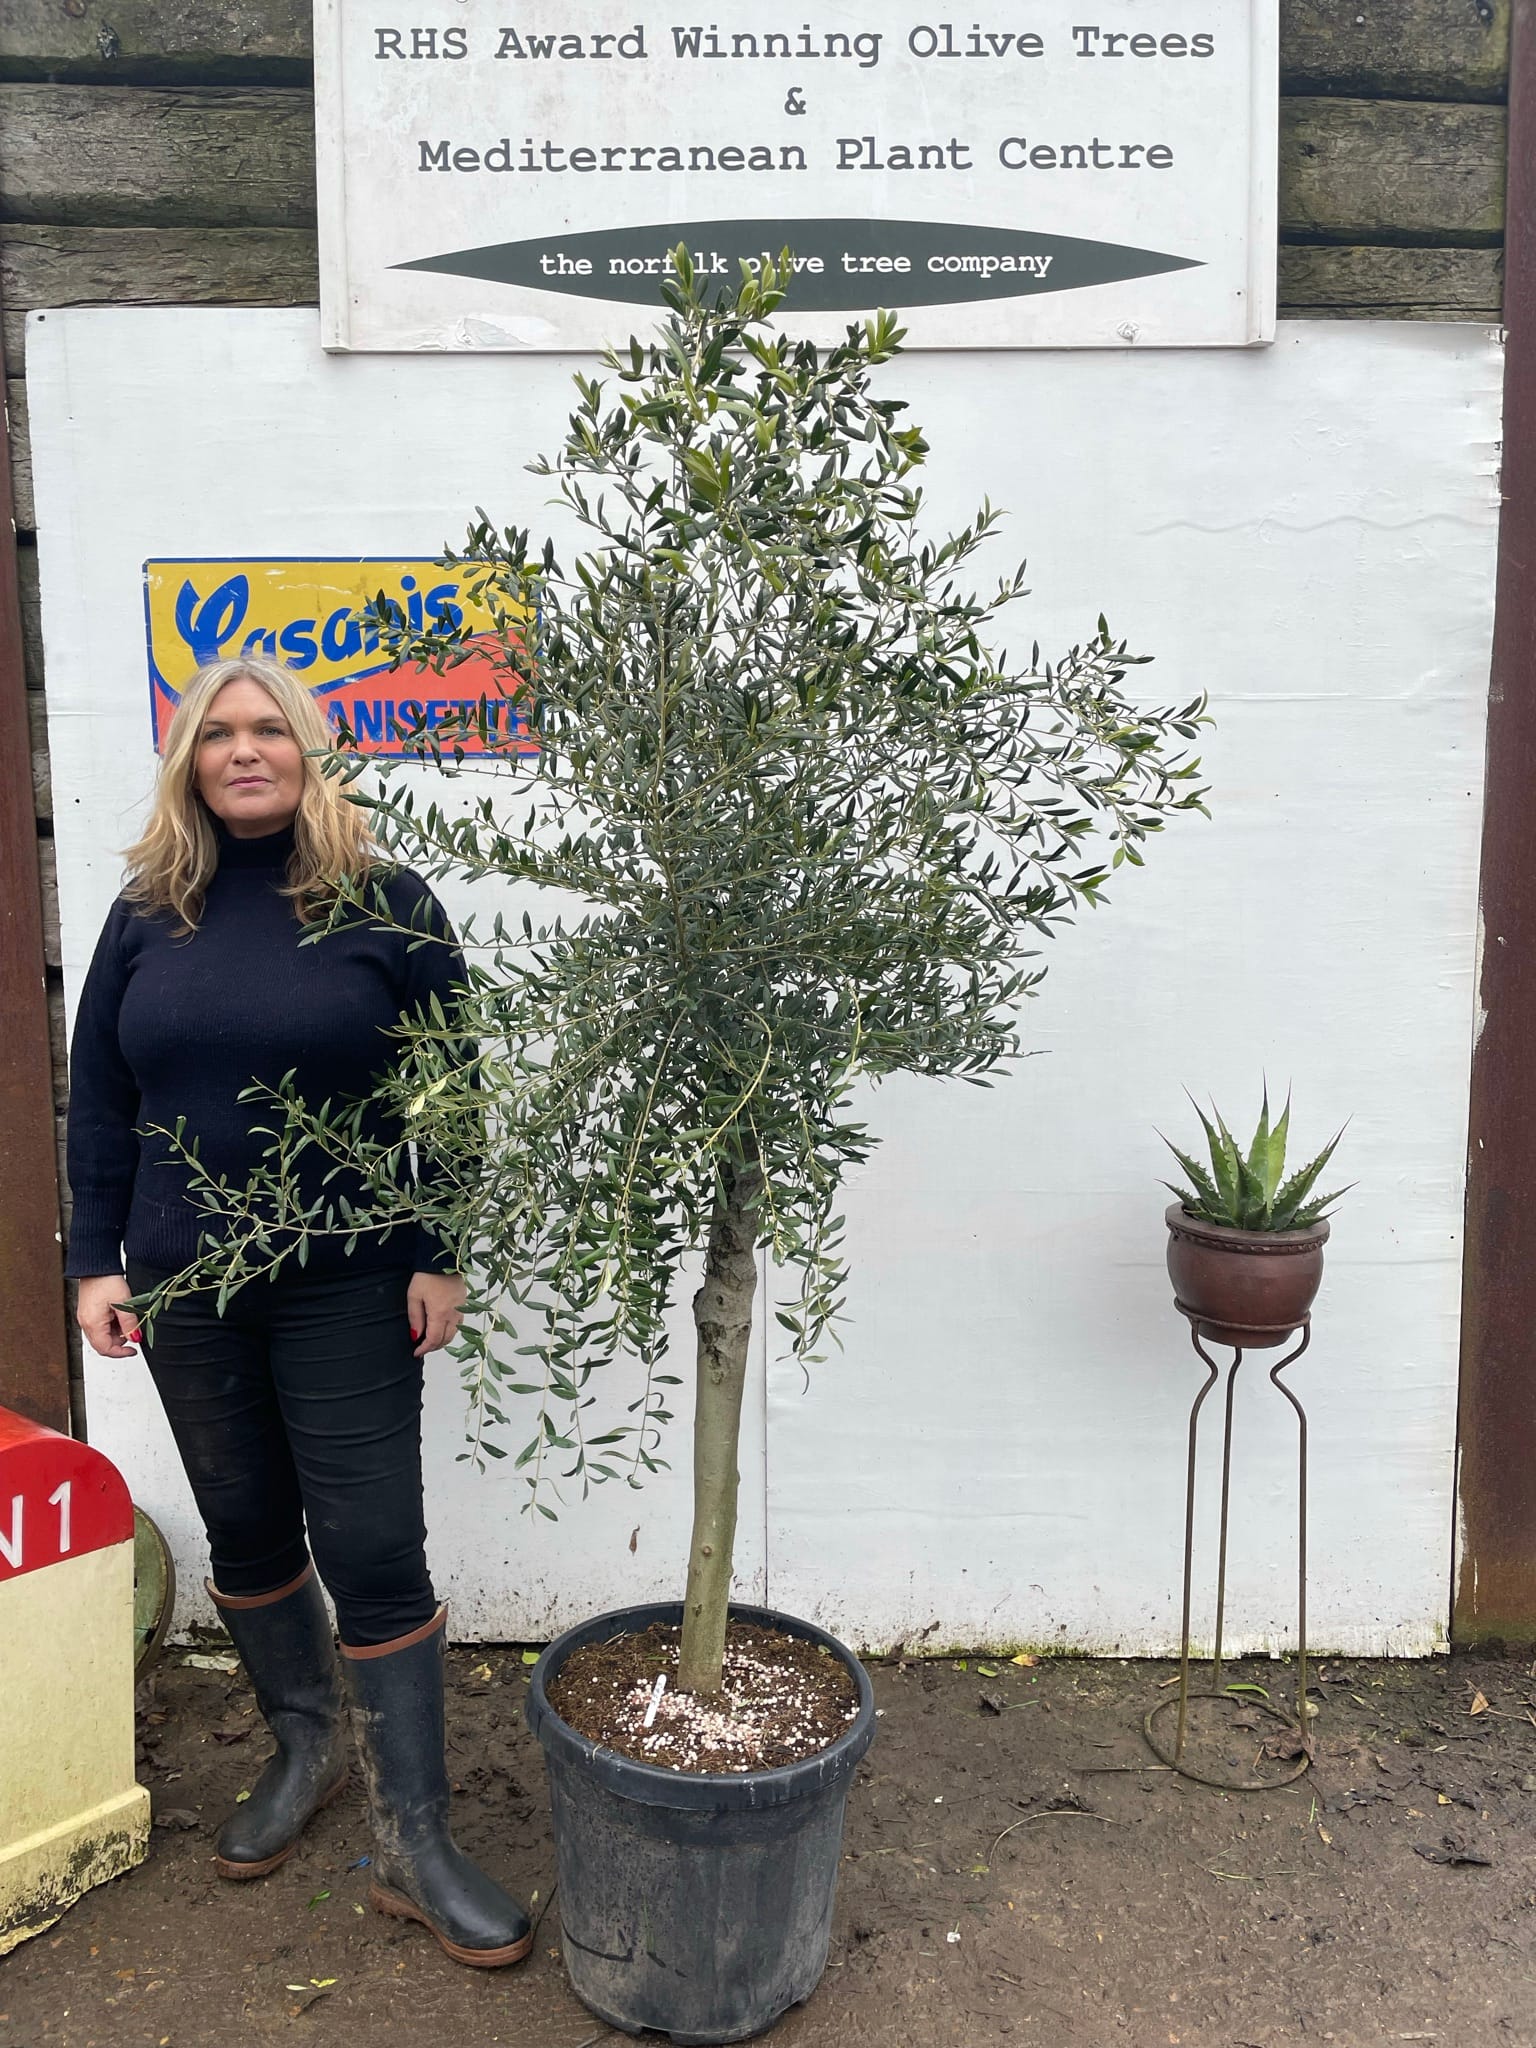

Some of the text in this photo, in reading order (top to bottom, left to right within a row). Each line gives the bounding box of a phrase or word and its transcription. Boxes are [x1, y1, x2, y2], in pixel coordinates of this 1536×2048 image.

[374, 23, 1215, 68] RHS Award Winning Olive Trees
[784, 86, 807, 116] &
[418, 136, 1174, 173] Mediterranean Plant Centre
[539, 253, 593, 275] the
[608, 252, 729, 275] norflk
[840, 252, 912, 273] tree
[927, 255, 1054, 279] company
